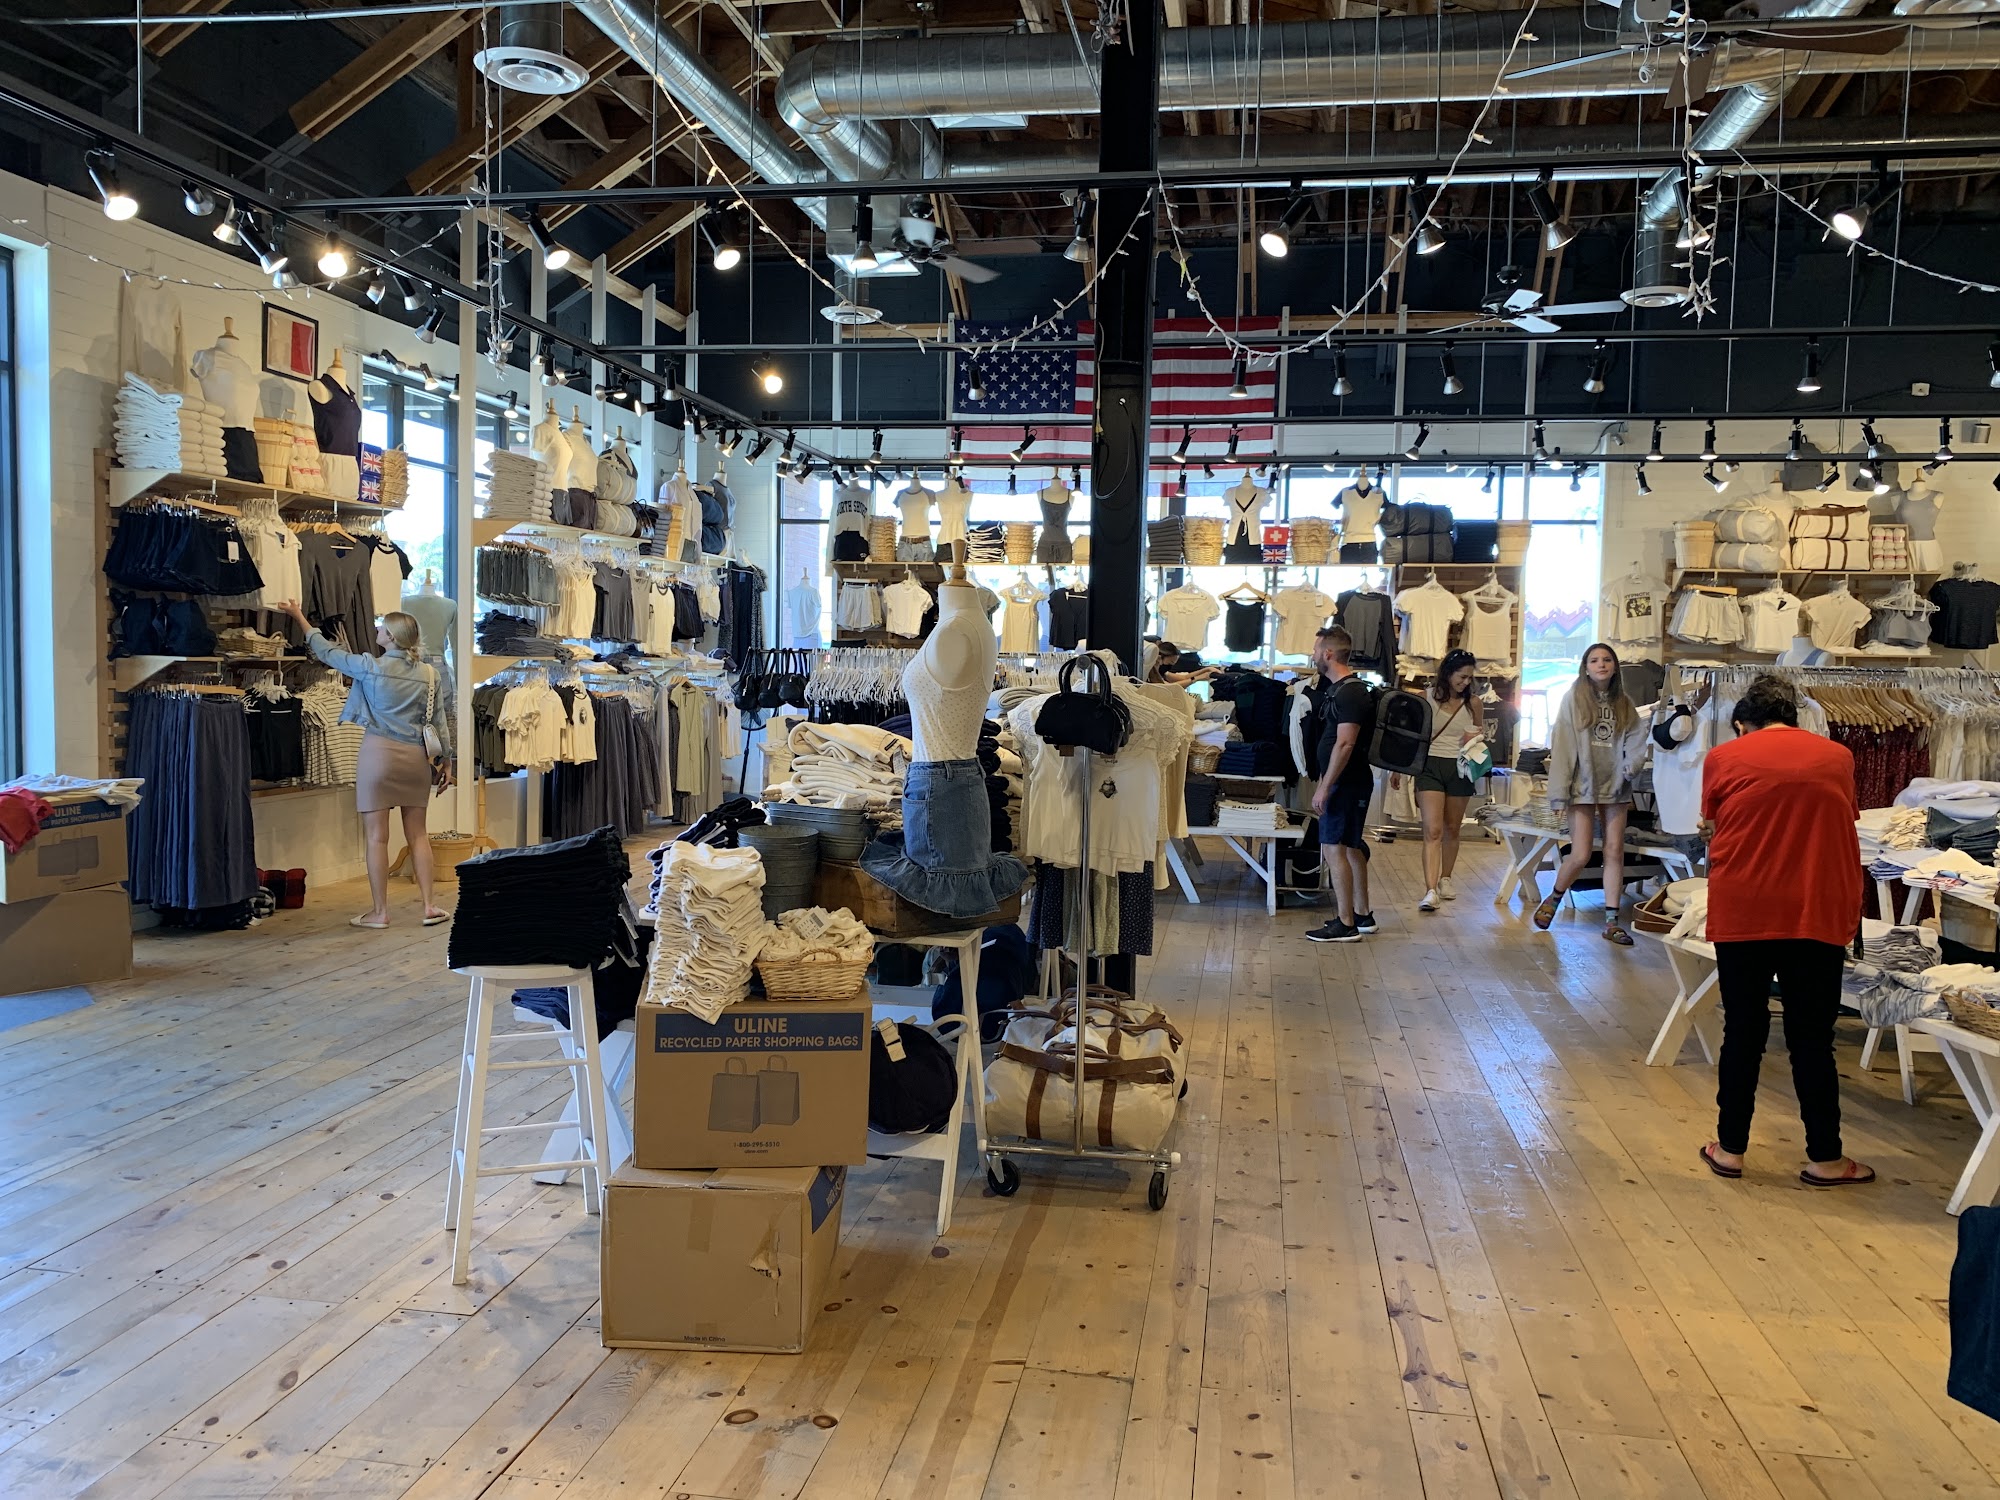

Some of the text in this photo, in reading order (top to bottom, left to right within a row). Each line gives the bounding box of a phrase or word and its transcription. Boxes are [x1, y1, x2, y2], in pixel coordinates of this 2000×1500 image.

[55, 806, 81, 817] ULINE
[50, 817, 69, 826] PAPER
[734, 1017, 788, 1033] ULINE
[659, 1035, 859, 1048] RECYCLED PAPER SHOPPING BAGS
